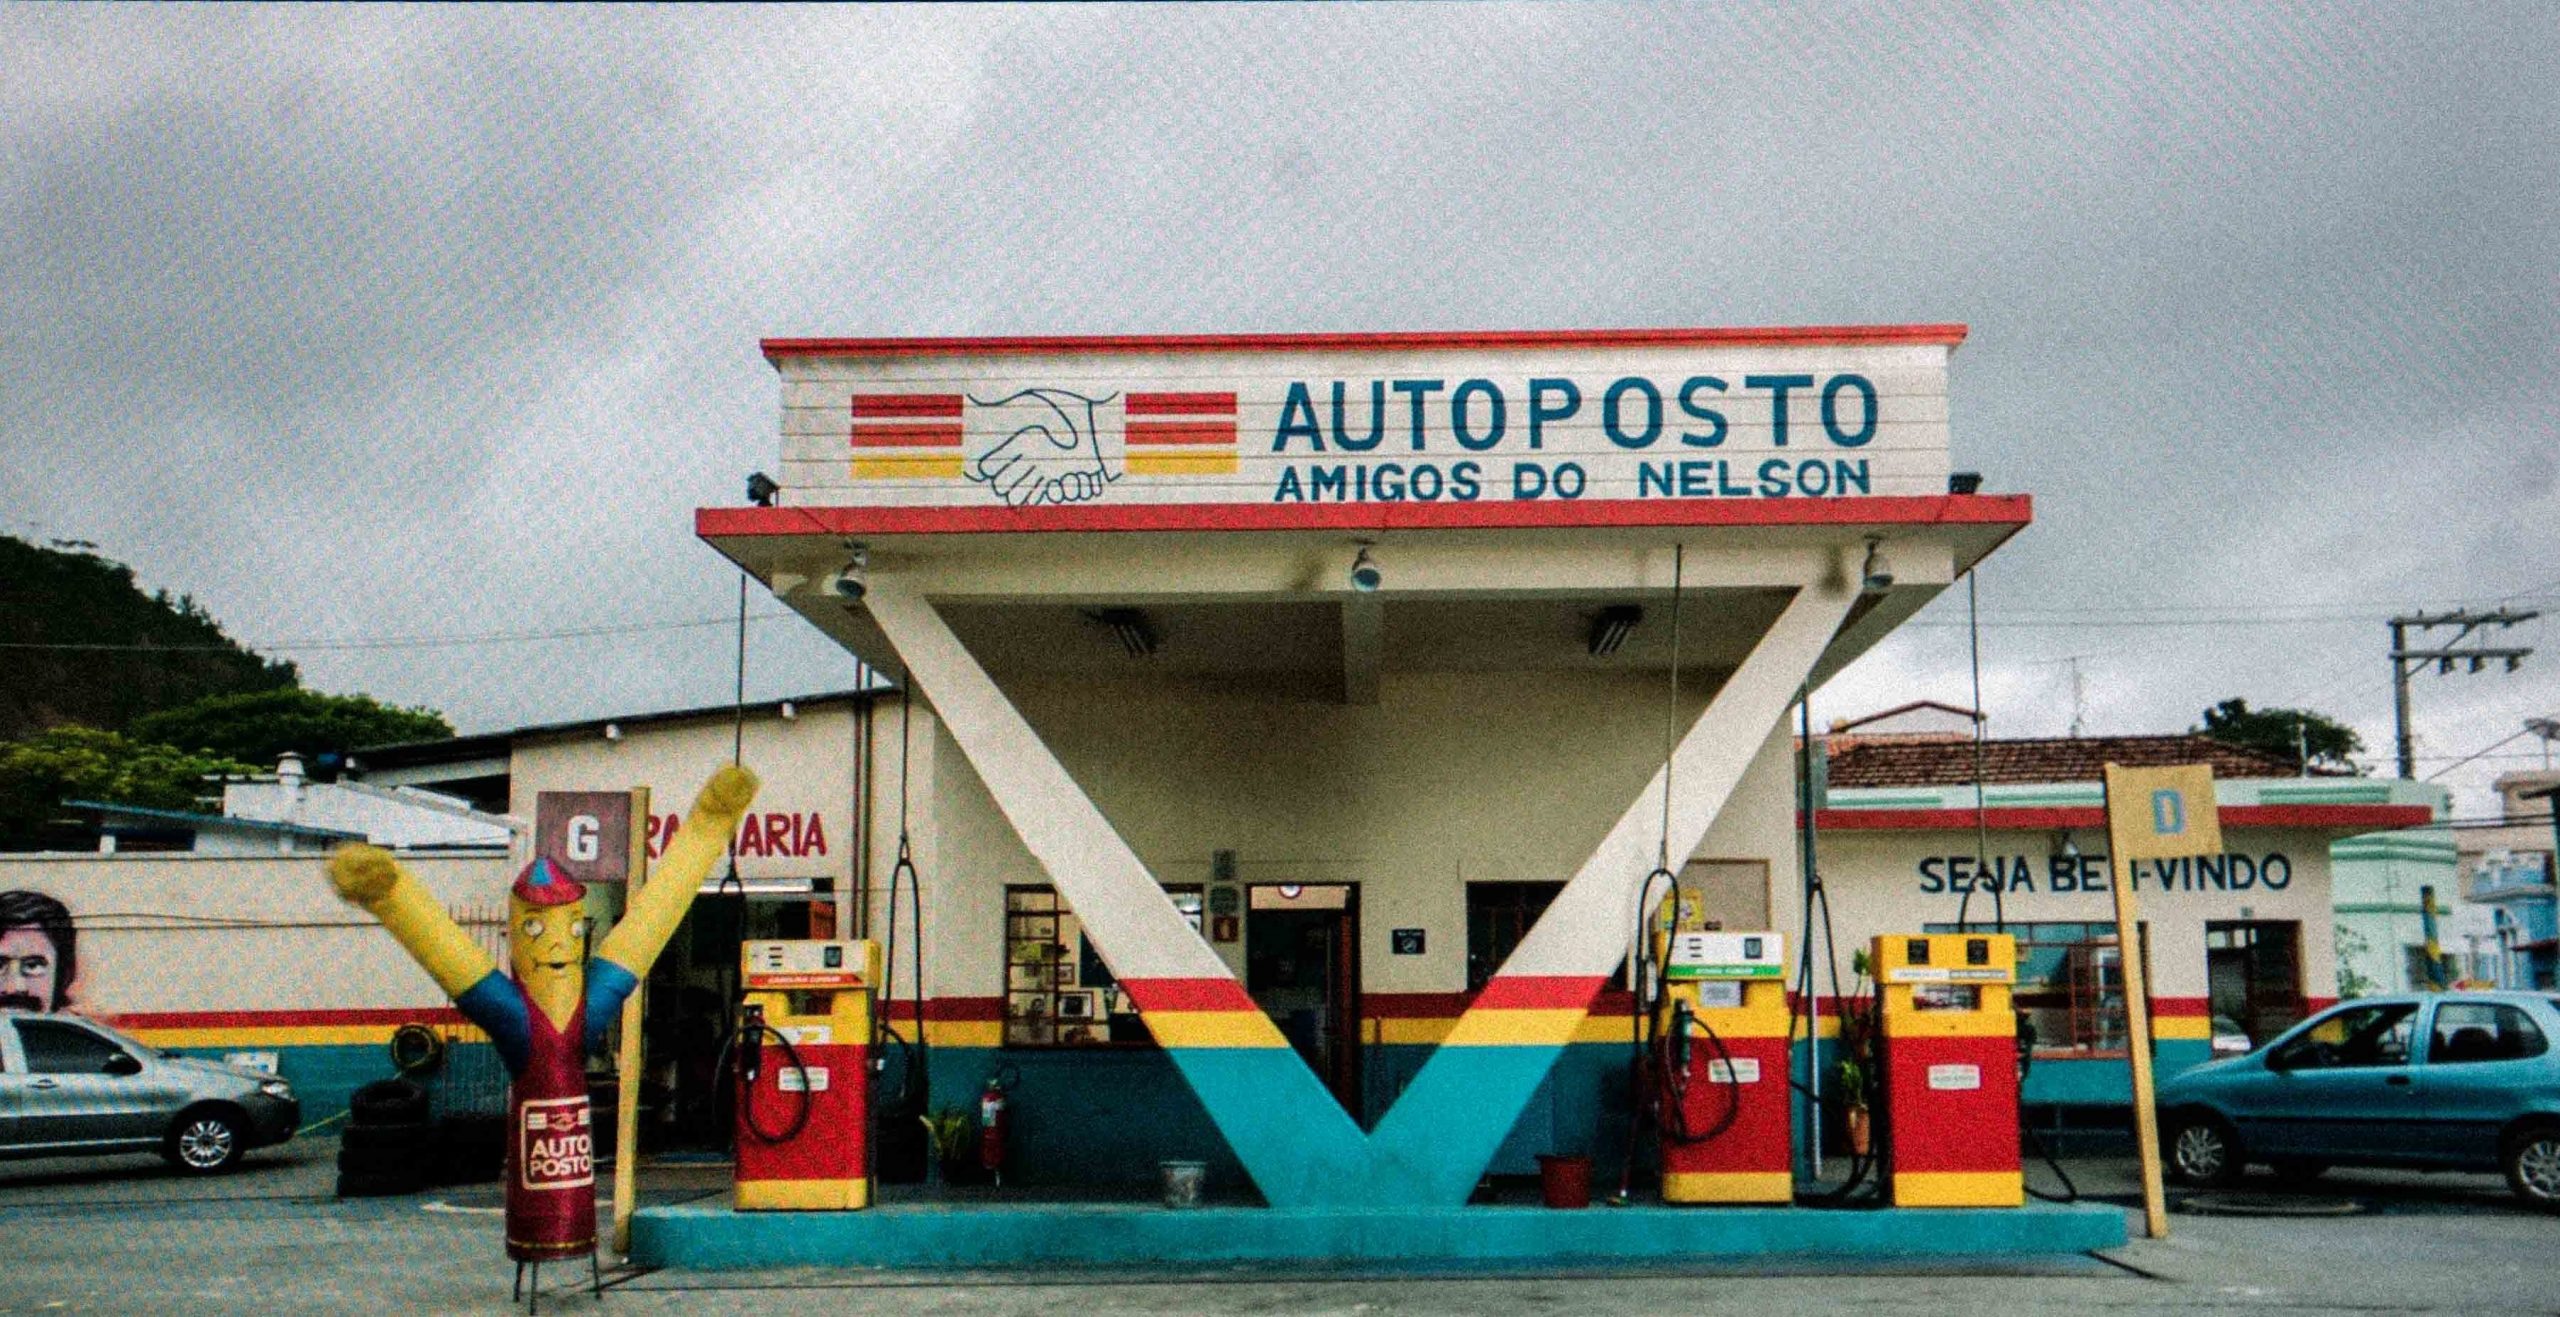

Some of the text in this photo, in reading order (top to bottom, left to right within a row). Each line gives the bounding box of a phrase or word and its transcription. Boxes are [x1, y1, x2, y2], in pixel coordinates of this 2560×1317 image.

[1275, 458, 1871, 502] AMIGOS DO NELSON
[2153, 789, 2185, 834] D
[566, 815, 600, 862] G
[1919, 855, 2035, 893] SEJA
[530, 1134, 590, 1159] AUTO
[530, 1155, 590, 1177] POSTO
